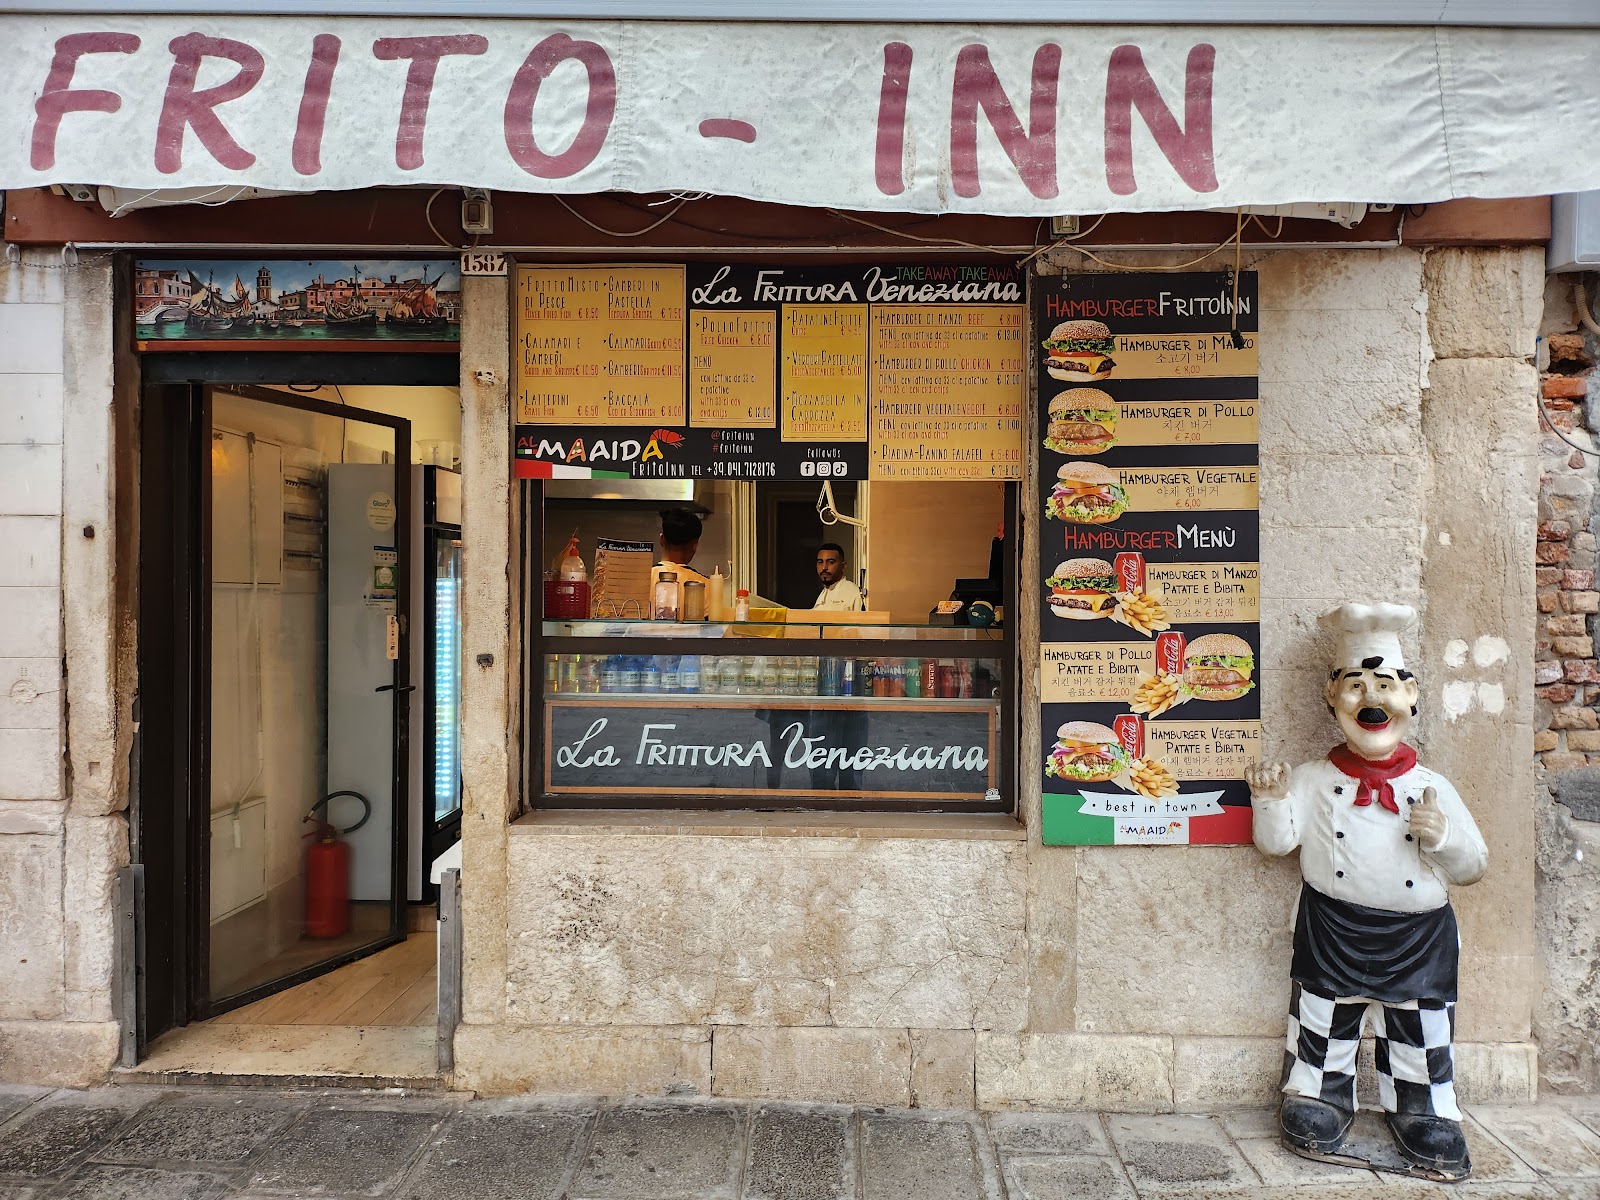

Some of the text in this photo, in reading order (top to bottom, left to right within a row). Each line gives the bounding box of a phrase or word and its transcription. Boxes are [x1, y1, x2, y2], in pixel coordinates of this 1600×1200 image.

[29, 30, 617, 179] FRITO
[874, 41, 1219, 199] INN
[463, 254, 507, 272] 1587
[608, 275, 660, 292] GAMBERI IN
[691, 265, 1021, 305] La FRITTURA Veneziana
[539, 292, 565, 309] PESCE
[608, 292, 651, 309] PASTELLA
[1046, 290, 1251, 318] HAMBURGER FRITOINN
[880, 308, 922, 326] HAMBURGER
[926, 313, 934, 326] DI
[938, 313, 963, 326] MANZO
[968, 313, 985, 326] BEEF
[1006, 314, 1021, 326] 8.00
[525, 332, 571, 350] CALAMARI
[608, 332, 648, 349] CALAMARI
[1120, 335, 1254, 352] HAMBURGER DI MAZO
[525, 348, 562, 366] GAMBERI
[879, 353, 991, 371] HAMBURGER DI POLLO CHICKEN
[608, 359, 641, 376] GAMBERI
[525, 389, 569, 406] LATTERINI
[791, 390, 846, 407] MOZZARELLA
[791, 405, 836, 422] CARROZZA
[879, 399, 922, 415] HAMBURGER
[926, 403, 961, 415] VEGETALE
[961, 403, 986, 415] VEGGIE
[1120, 403, 1254, 419] HAMBURGER DI POLLO
[1174, 432, 1182, 442] €
[517, 435, 663, 463] AL MAAIDA
[882, 444, 983, 461] PIADINA-PANINO FALAFEL
[691, 464, 703, 476] TEL
[706, 461, 776, 477] +39.041.7128176
[1119, 469, 1257, 486] HAMBURGER VEGETALE
[1175, 498, 1182, 508] €
[1064, 523, 1236, 551] HAMBURGER MENÙ
[1148, 566, 1258, 581] HAMBURGER DI MANZO
[1161, 581, 1245, 595] PATATE E BIBITA
[1205, 608, 1211, 618] €
[1044, 647, 1152, 661] HAMBURGER DI POLLO
[1056, 661, 1140, 675] PATATE E BIBITA
[1099, 687, 1106, 697] €
[1151, 726, 1259, 740] HAMBURGER VEGETALE
[556, 717, 990, 772] La FRITTURA Veneziana
[1164, 740, 1245, 754] PATATE E BIBITA
[1105, 799, 1198, 813] best in town
[1126, 825, 1175, 836] MAAIDA
